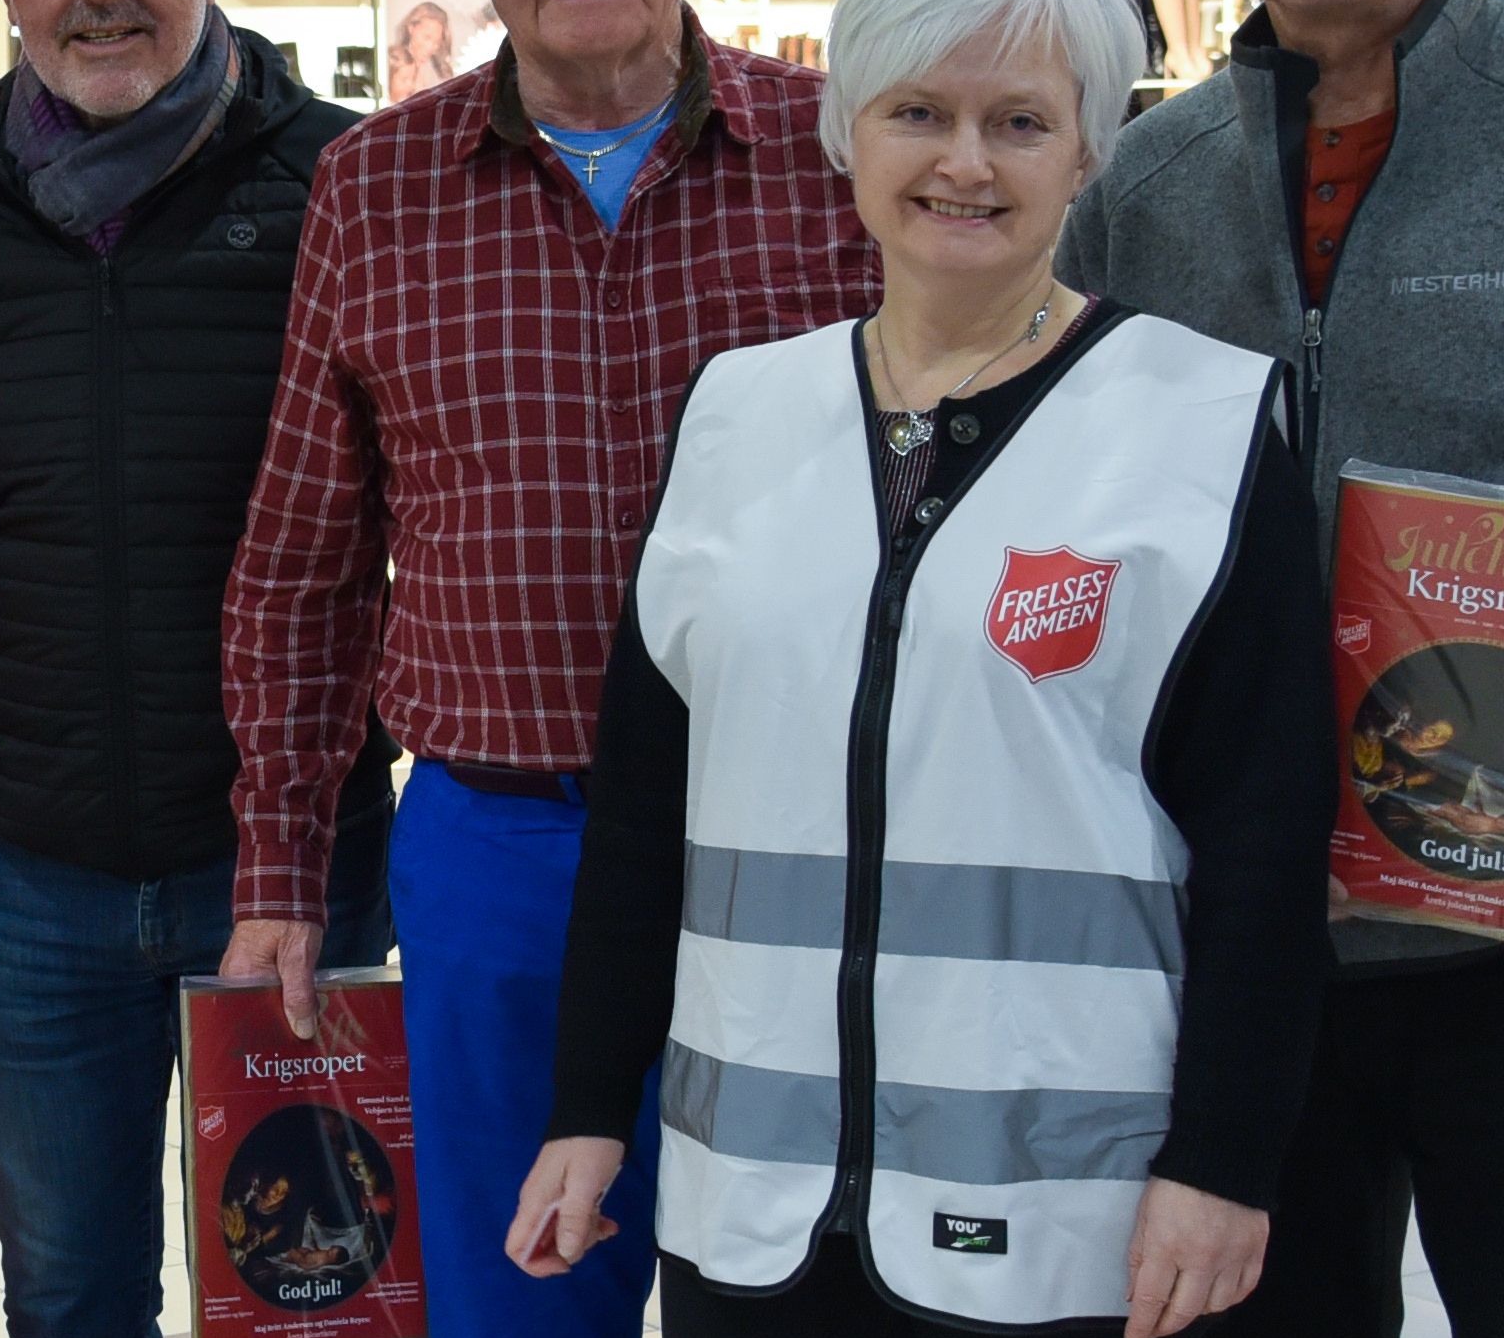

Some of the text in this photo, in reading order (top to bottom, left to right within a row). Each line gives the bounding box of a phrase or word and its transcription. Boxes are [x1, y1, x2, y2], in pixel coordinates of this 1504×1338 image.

[997, 570, 1107, 622] FRELSES-
[1002, 601, 1099, 647] ARMEEN
[1420, 839, 1465, 863] God
[1464, 891, 1476, 902] og
[244, 1052, 366, 1083] Krigsropet
[279, 1281, 311, 1300] God
[313, 1279, 342, 1302] jul!
